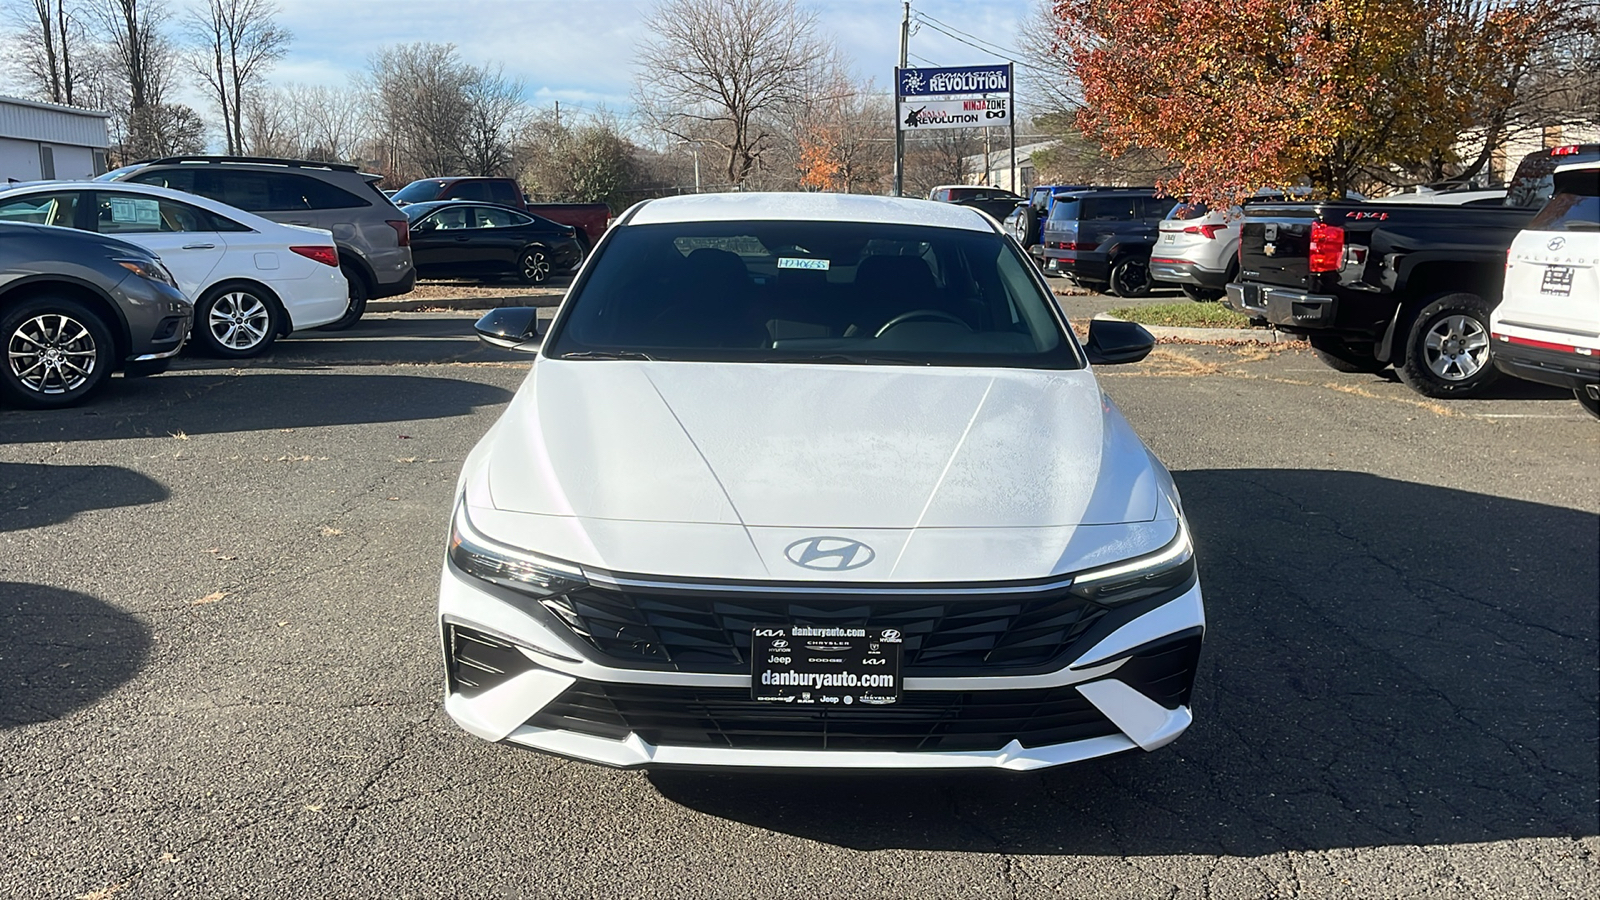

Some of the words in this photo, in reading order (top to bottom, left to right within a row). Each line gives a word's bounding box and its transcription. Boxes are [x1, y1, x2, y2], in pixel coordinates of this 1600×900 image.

[932, 70, 1003, 81] GYMNASTICS
[929, 75, 1007, 92] REVOLUTION
[963, 100, 1006, 111] NINJAZONE
[917, 114, 978, 125] REVOLUTION
[1517, 254, 1599, 264] PALISADE
[792, 625, 865, 638] danburyauto.com
[768, 655, 792, 665] Jeep
[761, 669, 894, 689] danburyauto.com
[820, 695, 840, 704] Jeep
